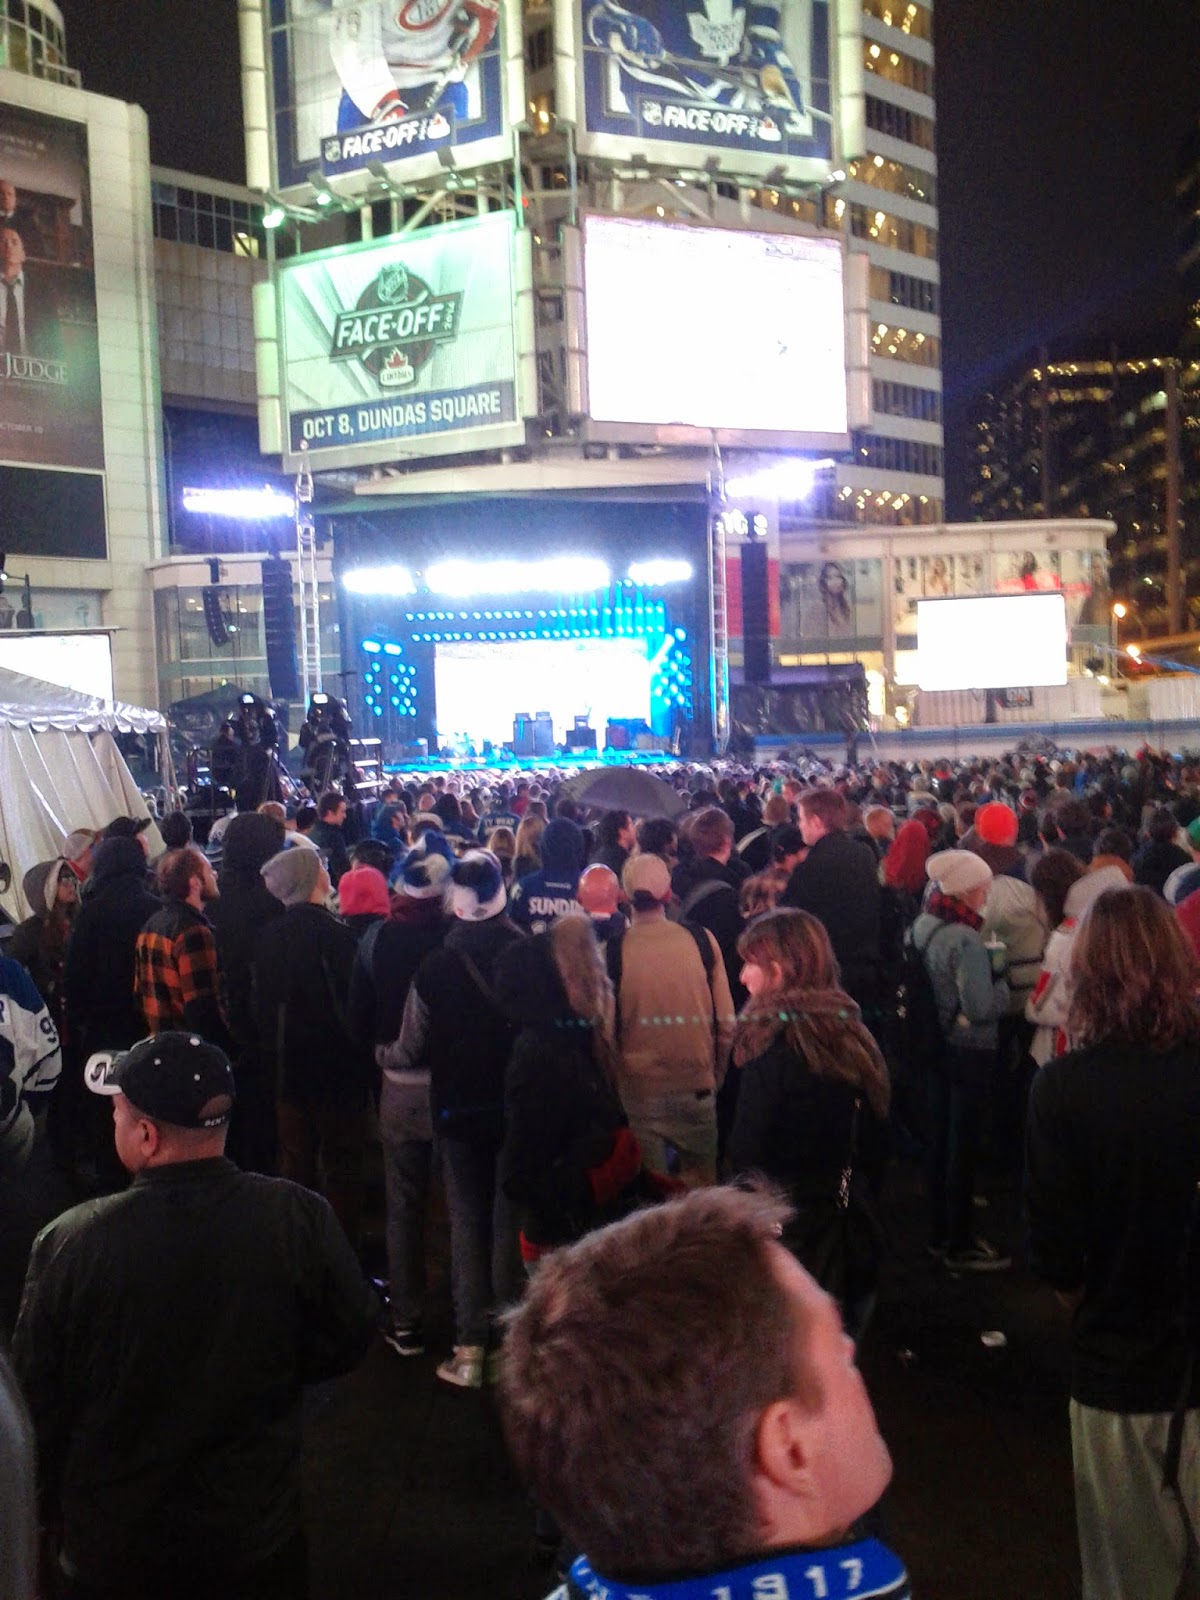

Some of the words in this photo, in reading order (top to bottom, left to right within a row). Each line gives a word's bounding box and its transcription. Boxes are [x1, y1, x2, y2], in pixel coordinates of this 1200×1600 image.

[342, 120, 420, 160] FACE-OFF
[664, 104, 751, 136] FACE-OFF
[336, 302, 445, 348] FACE-OFF
[303, 415, 335, 440] OCT
[338, 412, 354, 437] 8,
[358, 402, 426, 433] DUNDAS
[430, 390, 501, 423] SQUARE
